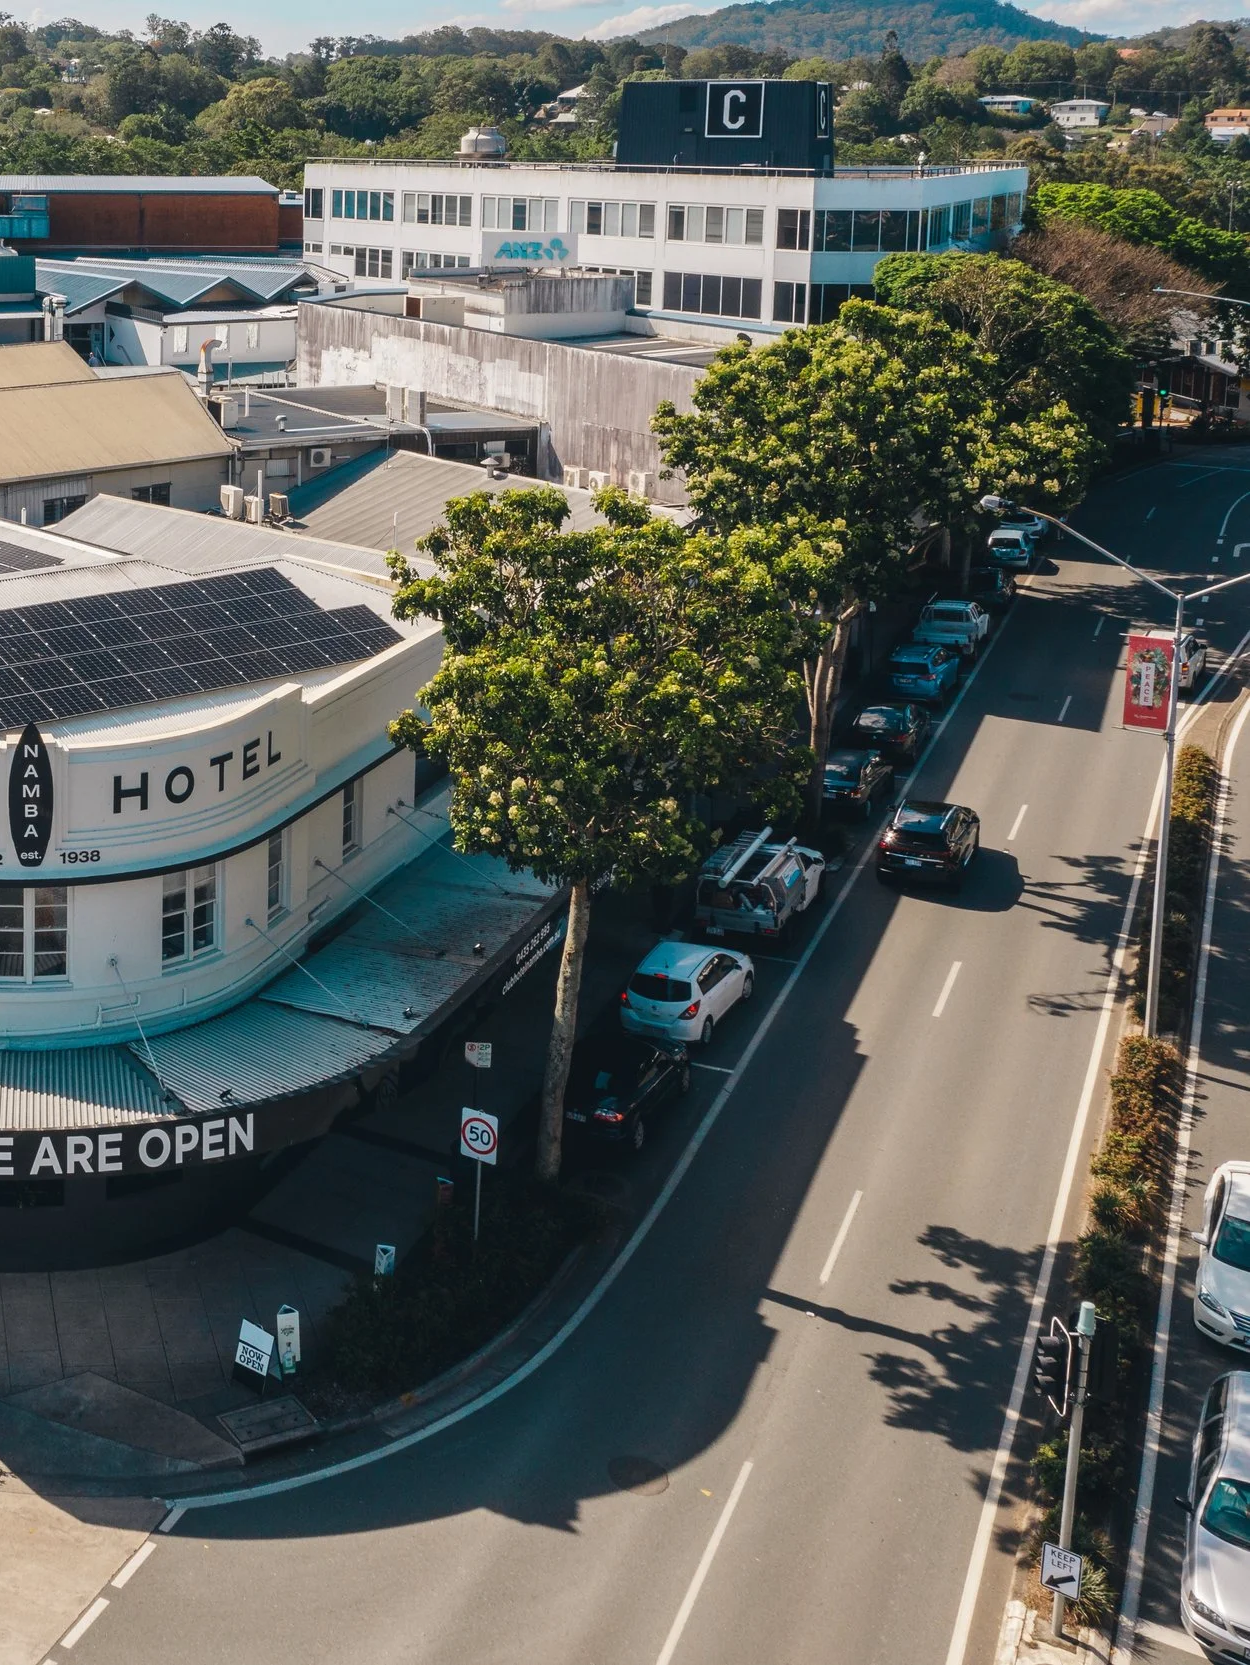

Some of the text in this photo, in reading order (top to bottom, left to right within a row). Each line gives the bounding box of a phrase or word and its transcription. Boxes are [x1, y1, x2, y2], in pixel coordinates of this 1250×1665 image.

[723, 90, 746, 129] C
[820, 90, 826, 130] C
[494, 241, 543, 260] ANZ
[1143, 665, 1151, 703] PEACE
[113, 731, 281, 814] HOTEL
[22, 744, 40, 838] NAMBA
[20, 851, 42, 860] est.
[59, 850, 101, 864] 1938
[29, 1132, 123, 1175] ARE
[138, 1113, 254, 1168] OPEN
[468, 1125, 491, 1146] 50
[239, 1354, 264, 1373] OPEN
[241, 1346, 264, 1362] NOW
[1051, 1549, 1076, 1563] KEEP
[1051, 1558, 1073, 1573] LEFT
